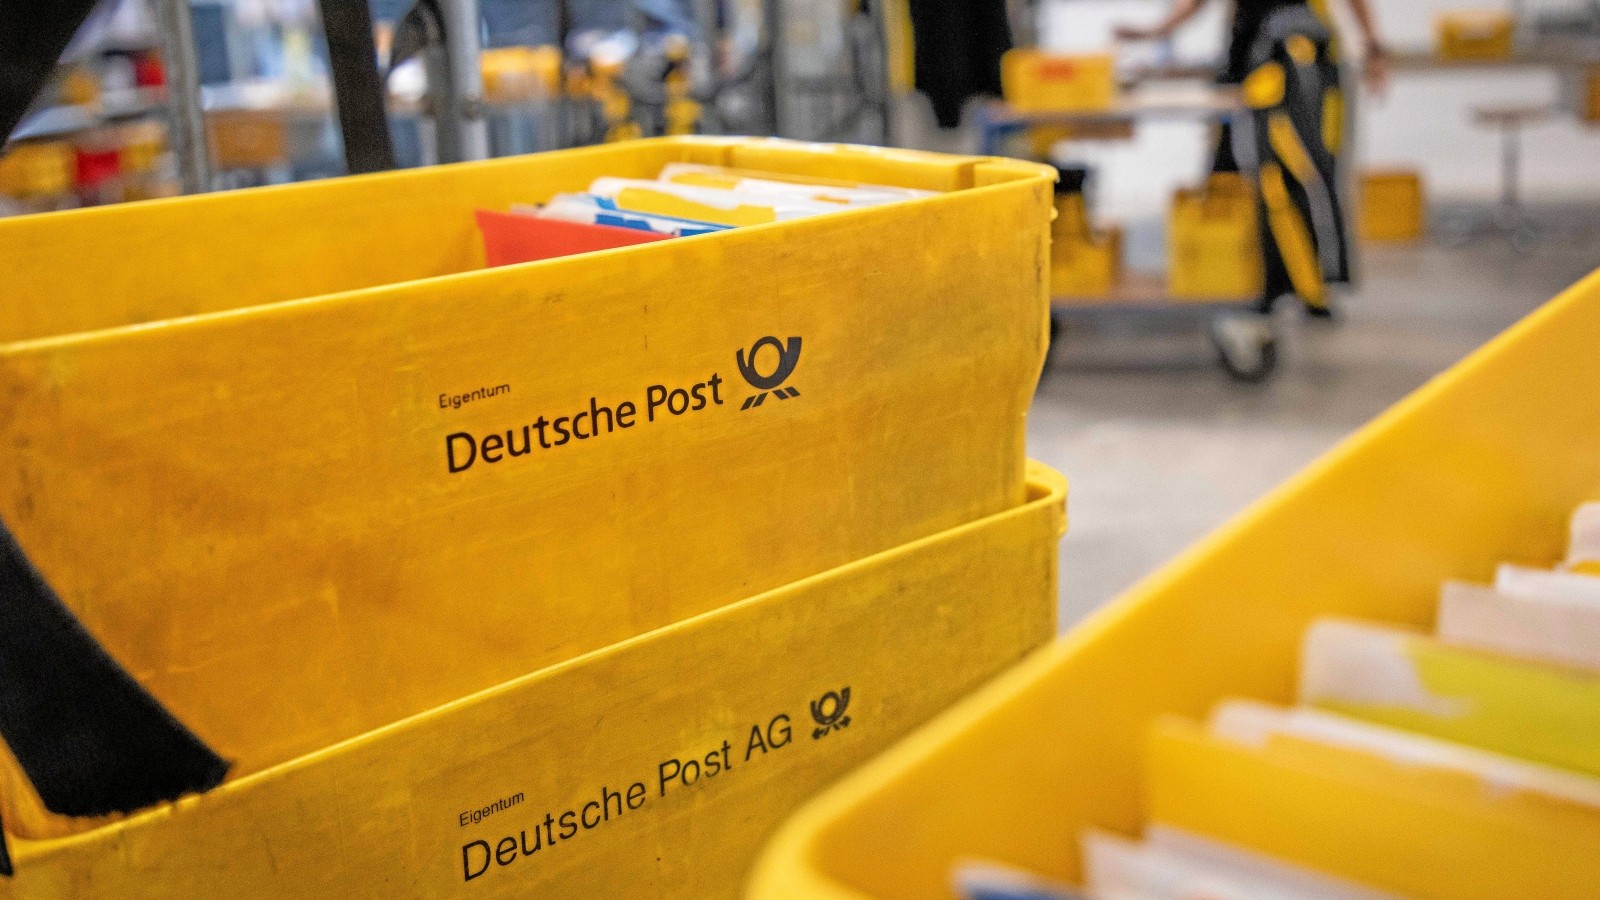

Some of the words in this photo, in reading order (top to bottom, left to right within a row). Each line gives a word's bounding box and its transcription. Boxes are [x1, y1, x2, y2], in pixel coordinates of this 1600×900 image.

[438, 383, 511, 409] Eigentum
[446, 397, 636, 473] Deutsche
[646, 373, 724, 422] Post
[459, 789, 525, 828] Eigentum
[461, 782, 647, 882] Deutsche
[657, 740, 732, 797] Post
[744, 713, 794, 762] AG
